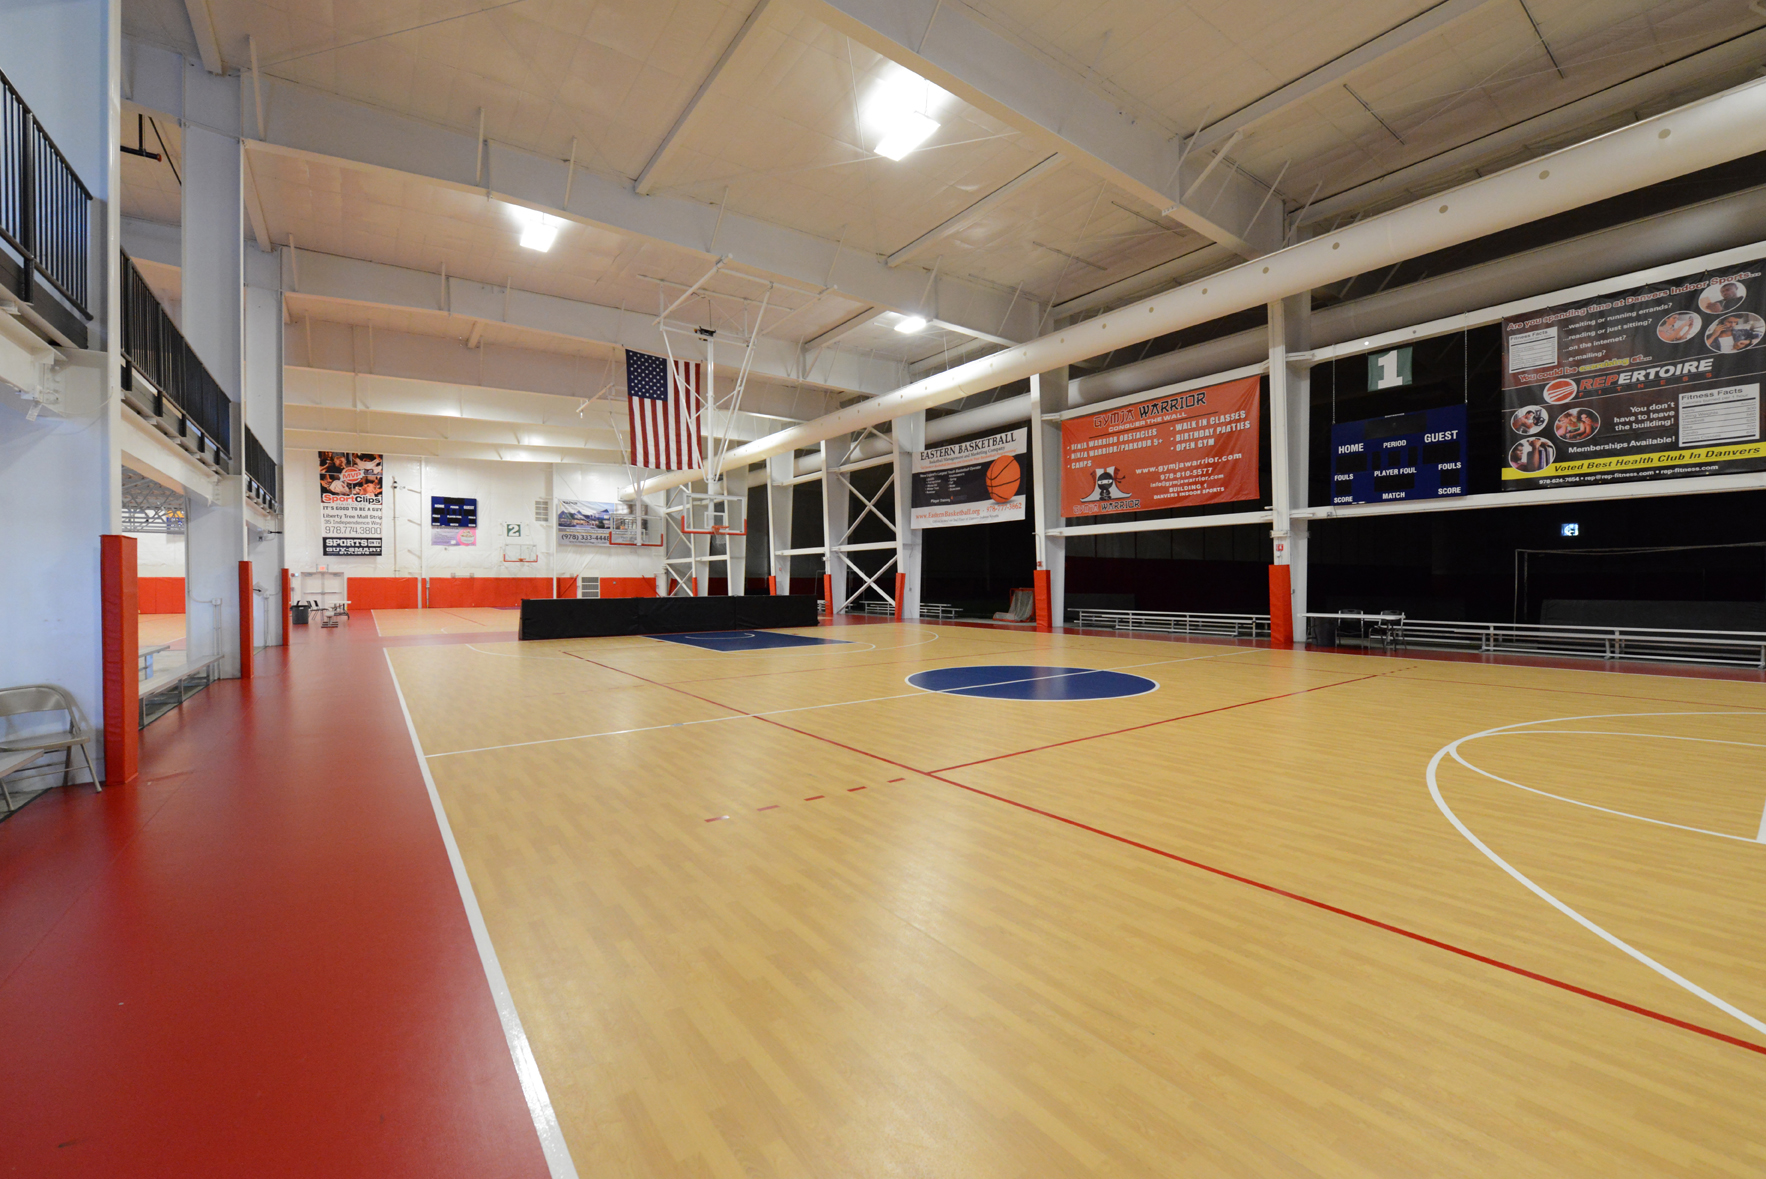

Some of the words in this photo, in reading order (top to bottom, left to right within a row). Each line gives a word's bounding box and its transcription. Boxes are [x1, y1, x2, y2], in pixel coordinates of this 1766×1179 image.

[1507, 322, 1524, 331] Are
[1524, 319, 1541, 328] you
[1543, 308, 1587, 323] spending
[1588, 302, 1612, 313] time
[1612, 299, 1625, 307] at
[1626, 289, 1669, 305] Danvers
[1671, 281, 1709, 295] Indoor
[1607, 311, 1637, 321] running
[1639, 302, 1673, 314] errands?
[1606, 324, 1622, 333] just
[1623, 318, 1652, 329] sitting?
[1579, 341, 1592, 349] the
[1593, 334, 1627, 346] internet?
[1377, 350, 1403, 389] 1
[1518, 374, 1537, 382] You
[1537, 368, 1563, 378] could
[1564, 366, 1578, 375] be
[1579, 356, 1630, 371] exercising
[1579, 358, 1714, 391] REPERTOIRE
[1681, 392, 1714, 401] Fitness
[1717, 387, 1743, 396] Facts
[1139, 392, 1206, 418] WARRIOR
[1649, 401, 1675, 411] don't
[1147, 416, 1162, 424] THE
[1163, 412, 1188, 421] WALL
[1175, 421, 1197, 431] WALK
[1199, 419, 1208, 427] IN
[1210, 410, 1246, 425] CLASSES
[1614, 415, 1636, 423] have
[1650, 410, 1675, 419] leave
[1176, 427, 1214, 442] BIRTHDAY
[1216, 420, 1251, 434] PARTIES
[1615, 423, 1630, 431] the
[1632, 418, 1674, 429] building!
[1088, 436, 1118, 448] WARRIOR
[1119, 428, 1157, 442] OBSTACLES
[1424, 430, 1459, 443] GUEST
[920, 445, 957, 461] EASTERN
[958, 432, 1017, 456] BASKETBALL
[988, 446, 1006, 454] Company
[1089, 439, 1152, 457] WARRIOR/PARKOUR
[1153, 438, 1163, 446] 5+
[1176, 441, 1196, 451] OPEN
[1198, 438, 1215, 448] GYM
[1338, 443, 1364, 454] HOME
[1383, 440, 1407, 449] PERIOD
[1568, 441, 1628, 453] Memberships
[1629, 436, 1675, 447] Available!
[1136, 452, 1242, 474] www.gymjawarrior.com
[1438, 462, 1462, 470] FOULS
[1554, 463, 1585, 472] Voted
[1586, 461, 1613, 470] Best
[1615, 456, 1654, 466] Health
[1657, 453, 1685, 462] Club
[1689, 451, 1701, 460] In
[1705, 447, 1761, 458] Danvers
[1160, 467, 1213, 480] 978-810-5577
[1374, 468, 1399, 477] PLAYER
[1400, 467, 1417, 475] FOUL
[1660, 465, 1719, 475] rep-fitness.com
[1150, 473, 1224, 488] info@gymjawarrior.com
[1153, 492, 1178, 500] DANVERS
[1179, 489, 1201, 497] INDOOR
[1202, 486, 1225, 495] SPORTS
[1169, 484, 1201, 493] BUILDING
[1382, 491, 1406, 499] MATCH
[1438, 486, 1462, 495] SCORE
[915, 508, 981, 519] www.EasternBasketball.org
[986, 502, 1022, 513] 978-777-3862
[1101, 499, 1140, 511] WARRIOR
[325, 525, 382, 535] 978.774.3800
[508, 524, 520, 536] 2
[561, 533, 579, 541] (978)
[326, 539, 368, 547] SPORTS
